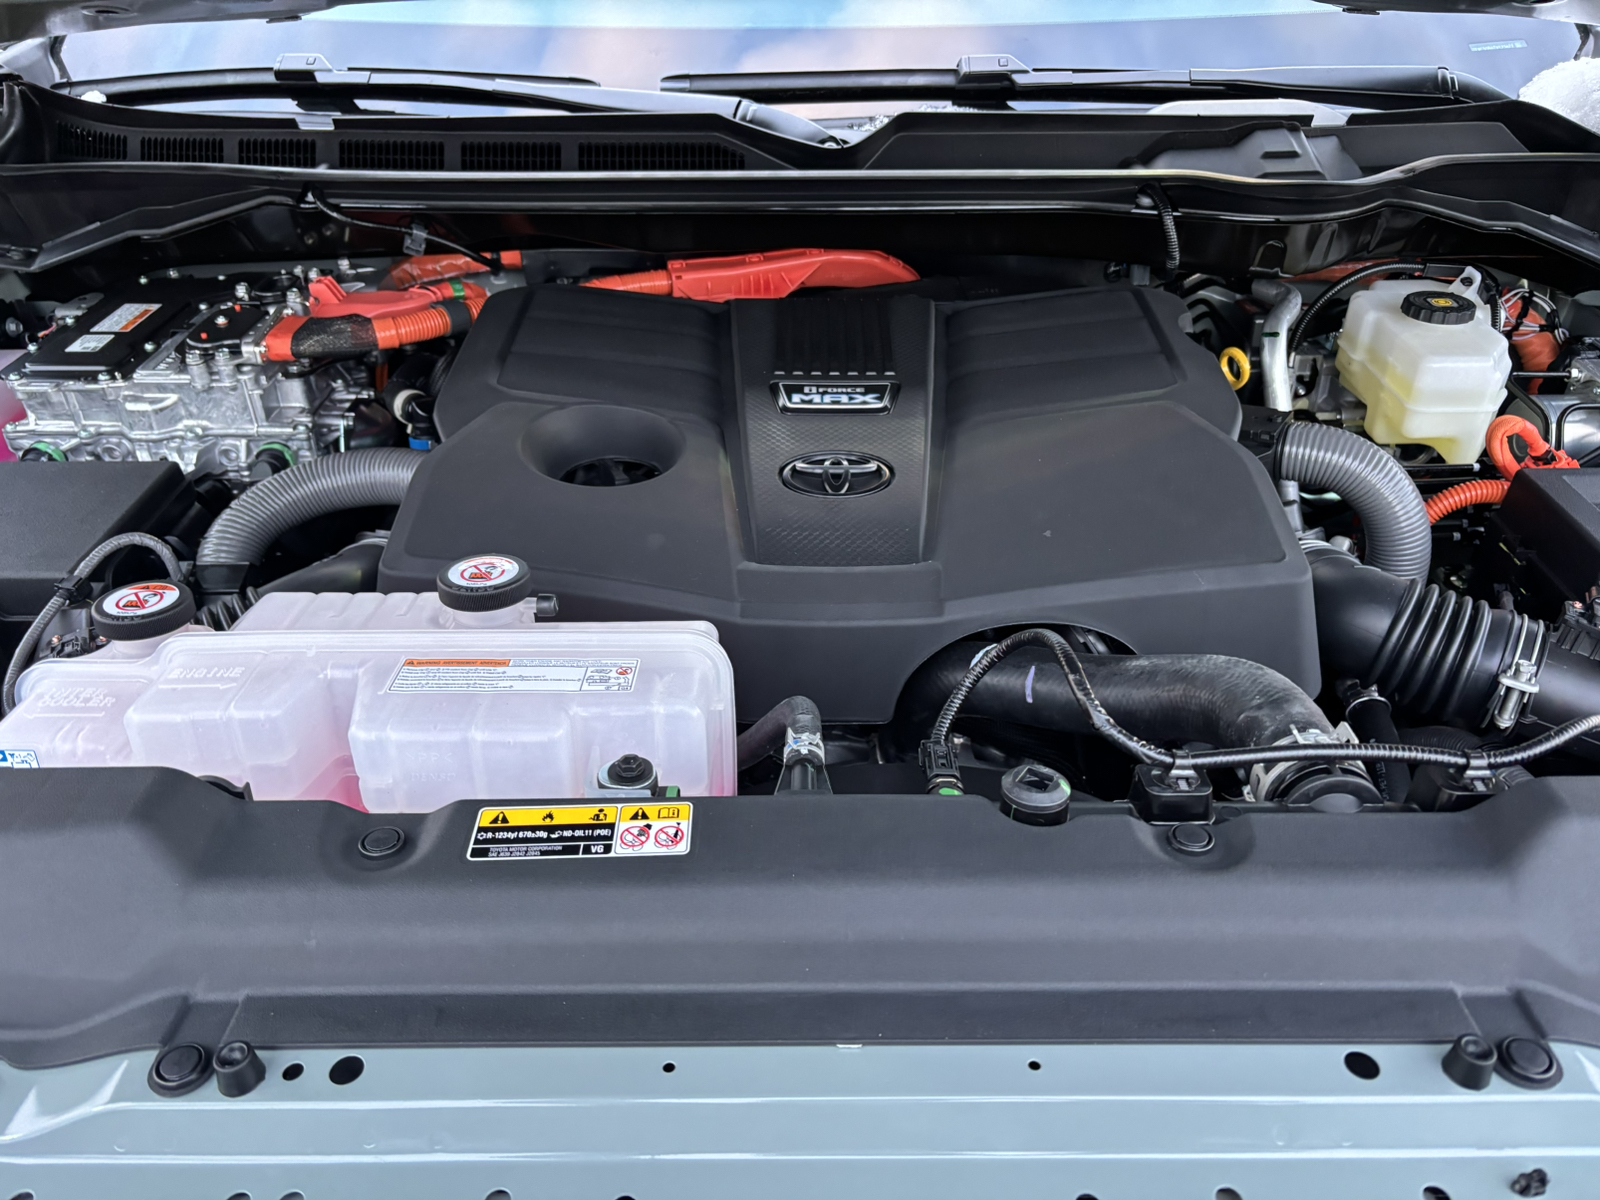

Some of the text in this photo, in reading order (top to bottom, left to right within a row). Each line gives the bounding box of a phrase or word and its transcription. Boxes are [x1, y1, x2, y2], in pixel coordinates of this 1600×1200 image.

[791, 393, 881, 404] MAX
[167, 667, 245, 679] ENGINE
[44, 687, 108, 699] INTER
[38, 696, 116, 707] COOLER
[486, 829, 612, 840] R-1234yf 670±30g ND-OIL11 (POE)
[590, 845, 605, 853] VG
